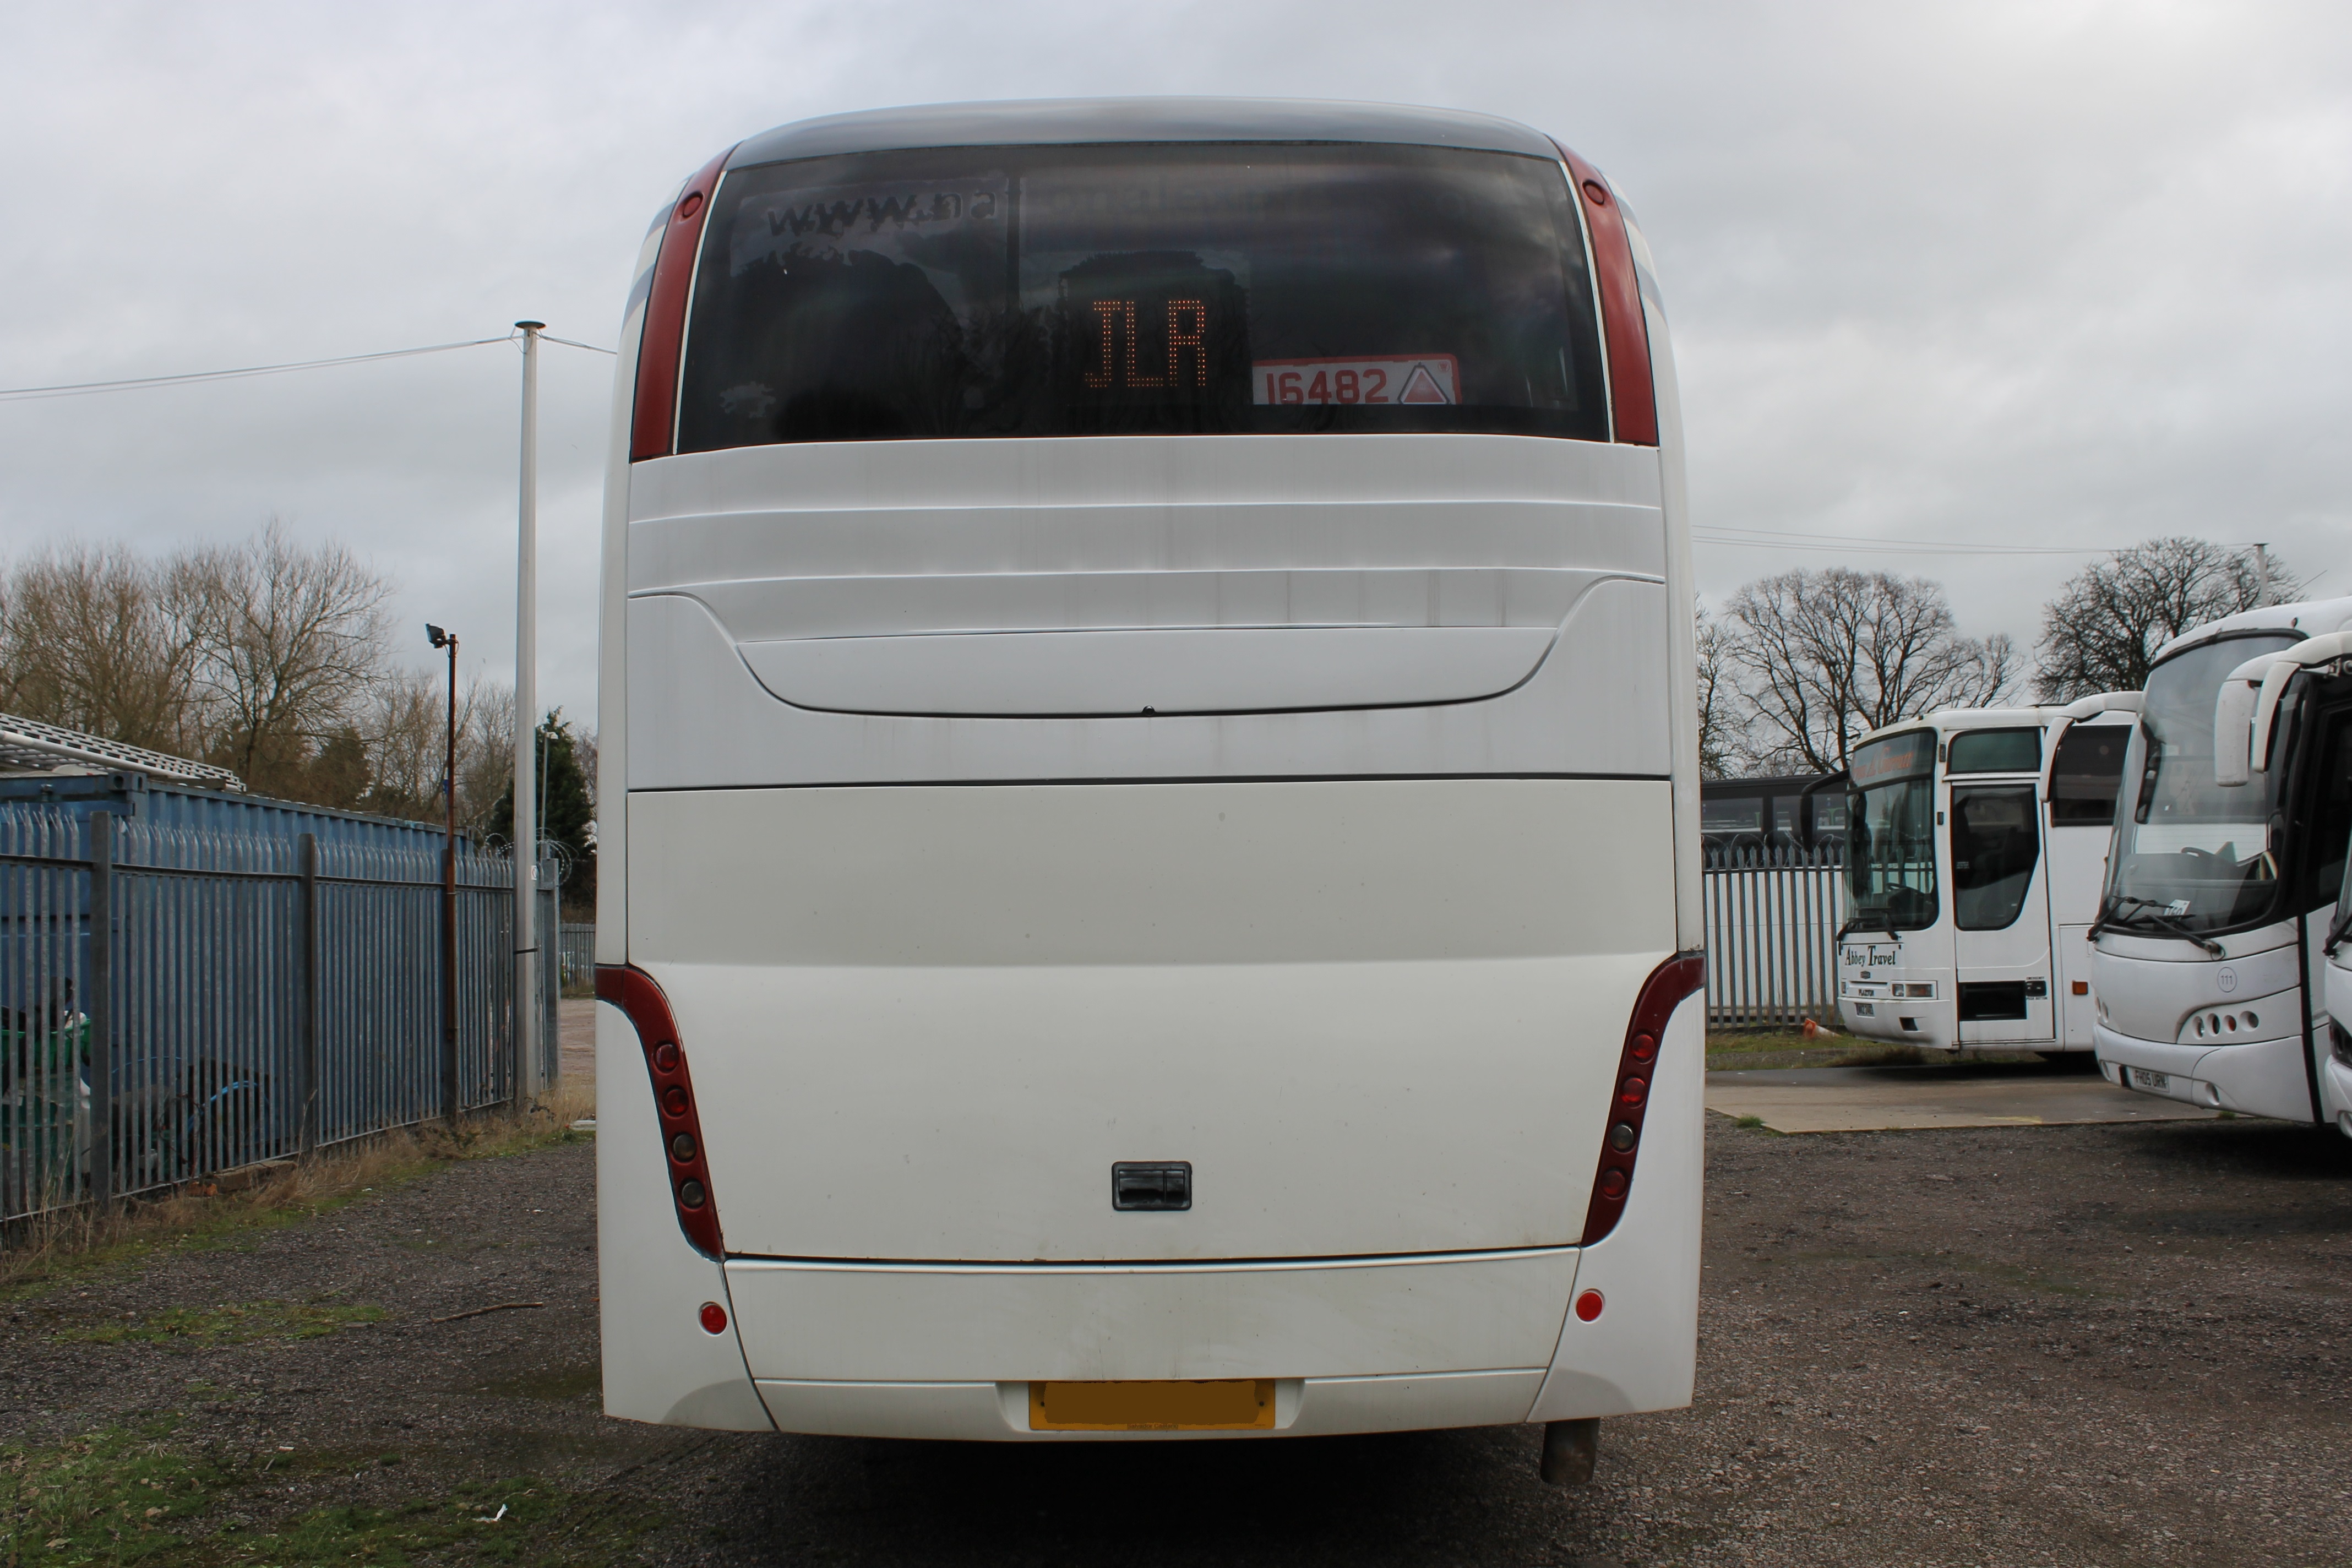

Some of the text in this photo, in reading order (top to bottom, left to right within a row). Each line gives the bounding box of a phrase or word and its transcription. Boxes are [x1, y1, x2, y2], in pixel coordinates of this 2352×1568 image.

[1085, 300, 1206, 388] JLR
[1266, 368, 1390, 405] 16482
[1845, 945, 1896, 967] Abbey Travel
[2220, 975, 2233, 985] 111
